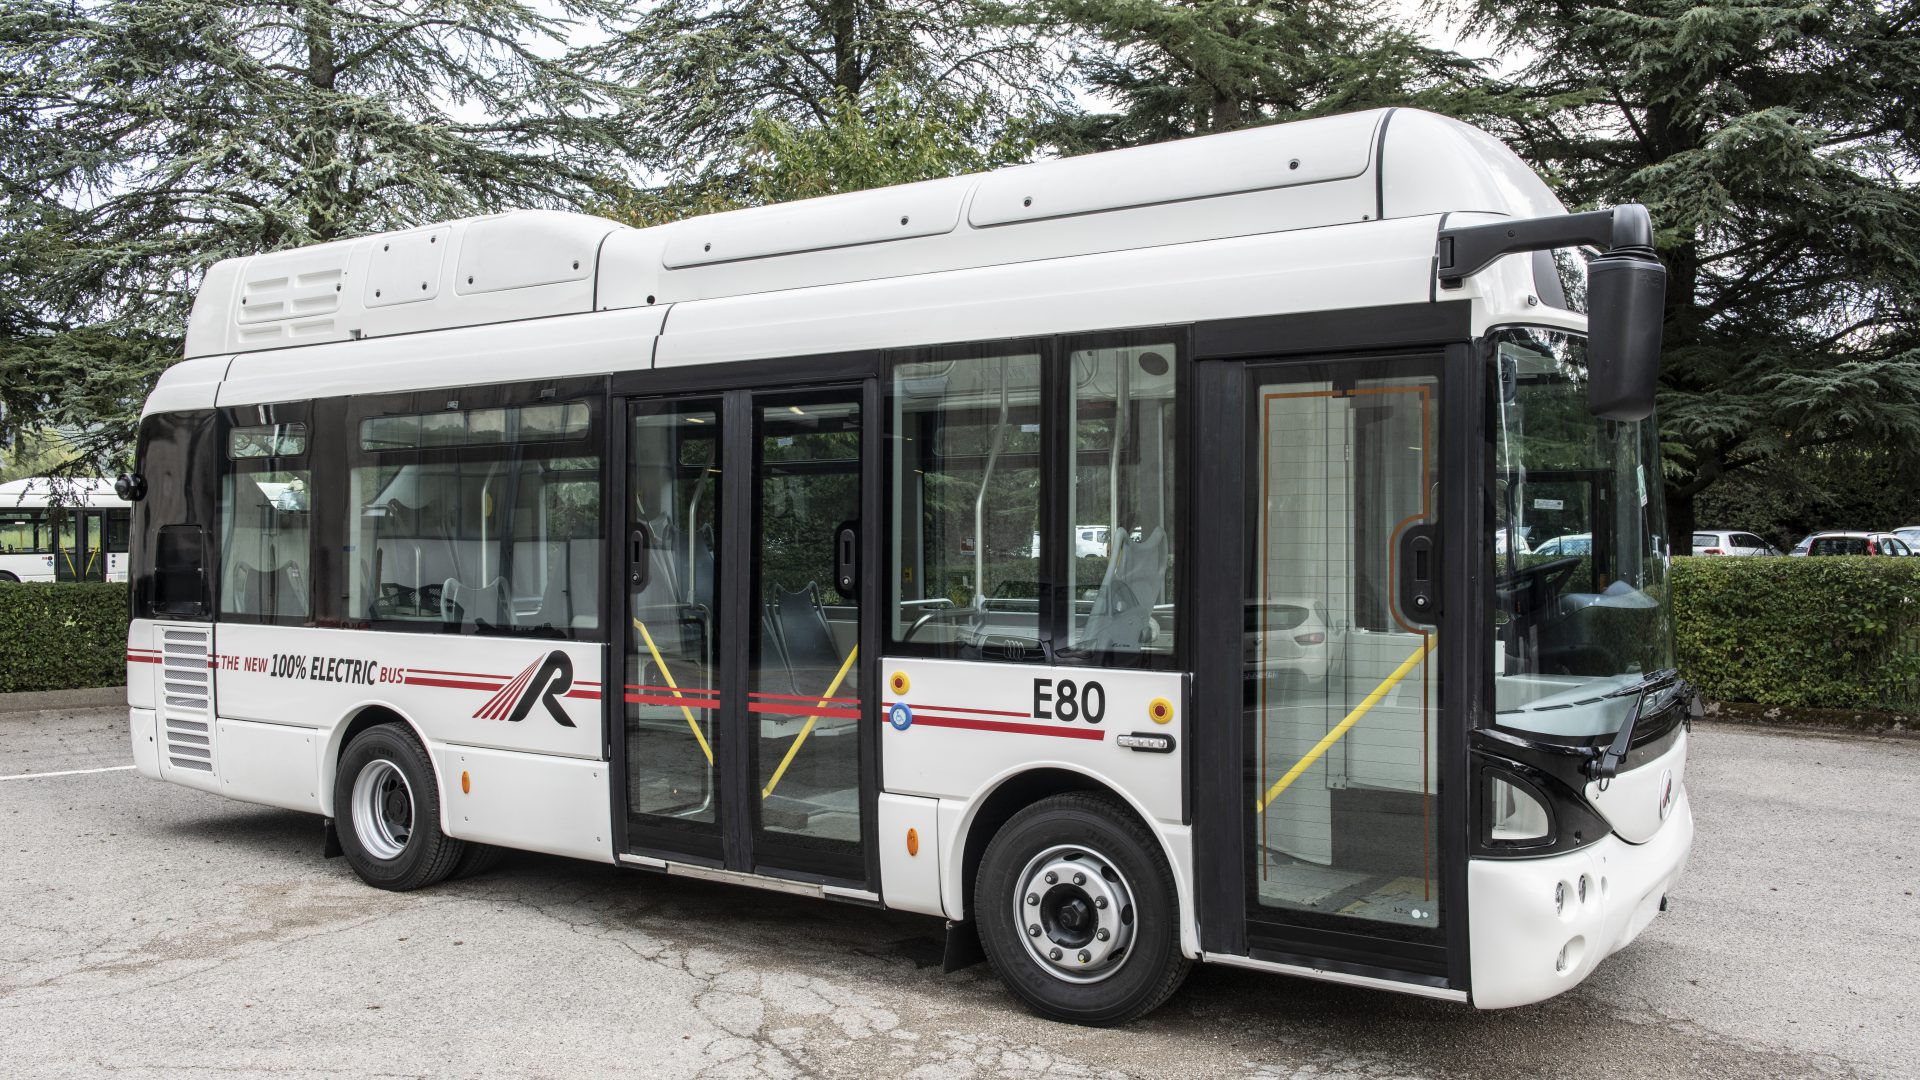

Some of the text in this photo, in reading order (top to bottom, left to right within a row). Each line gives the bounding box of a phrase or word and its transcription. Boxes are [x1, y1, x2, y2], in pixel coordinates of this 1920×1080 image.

[221, 653, 405, 686] THE NEW 100% ELECTRIC BUS
[1033, 677, 1106, 725] E80
